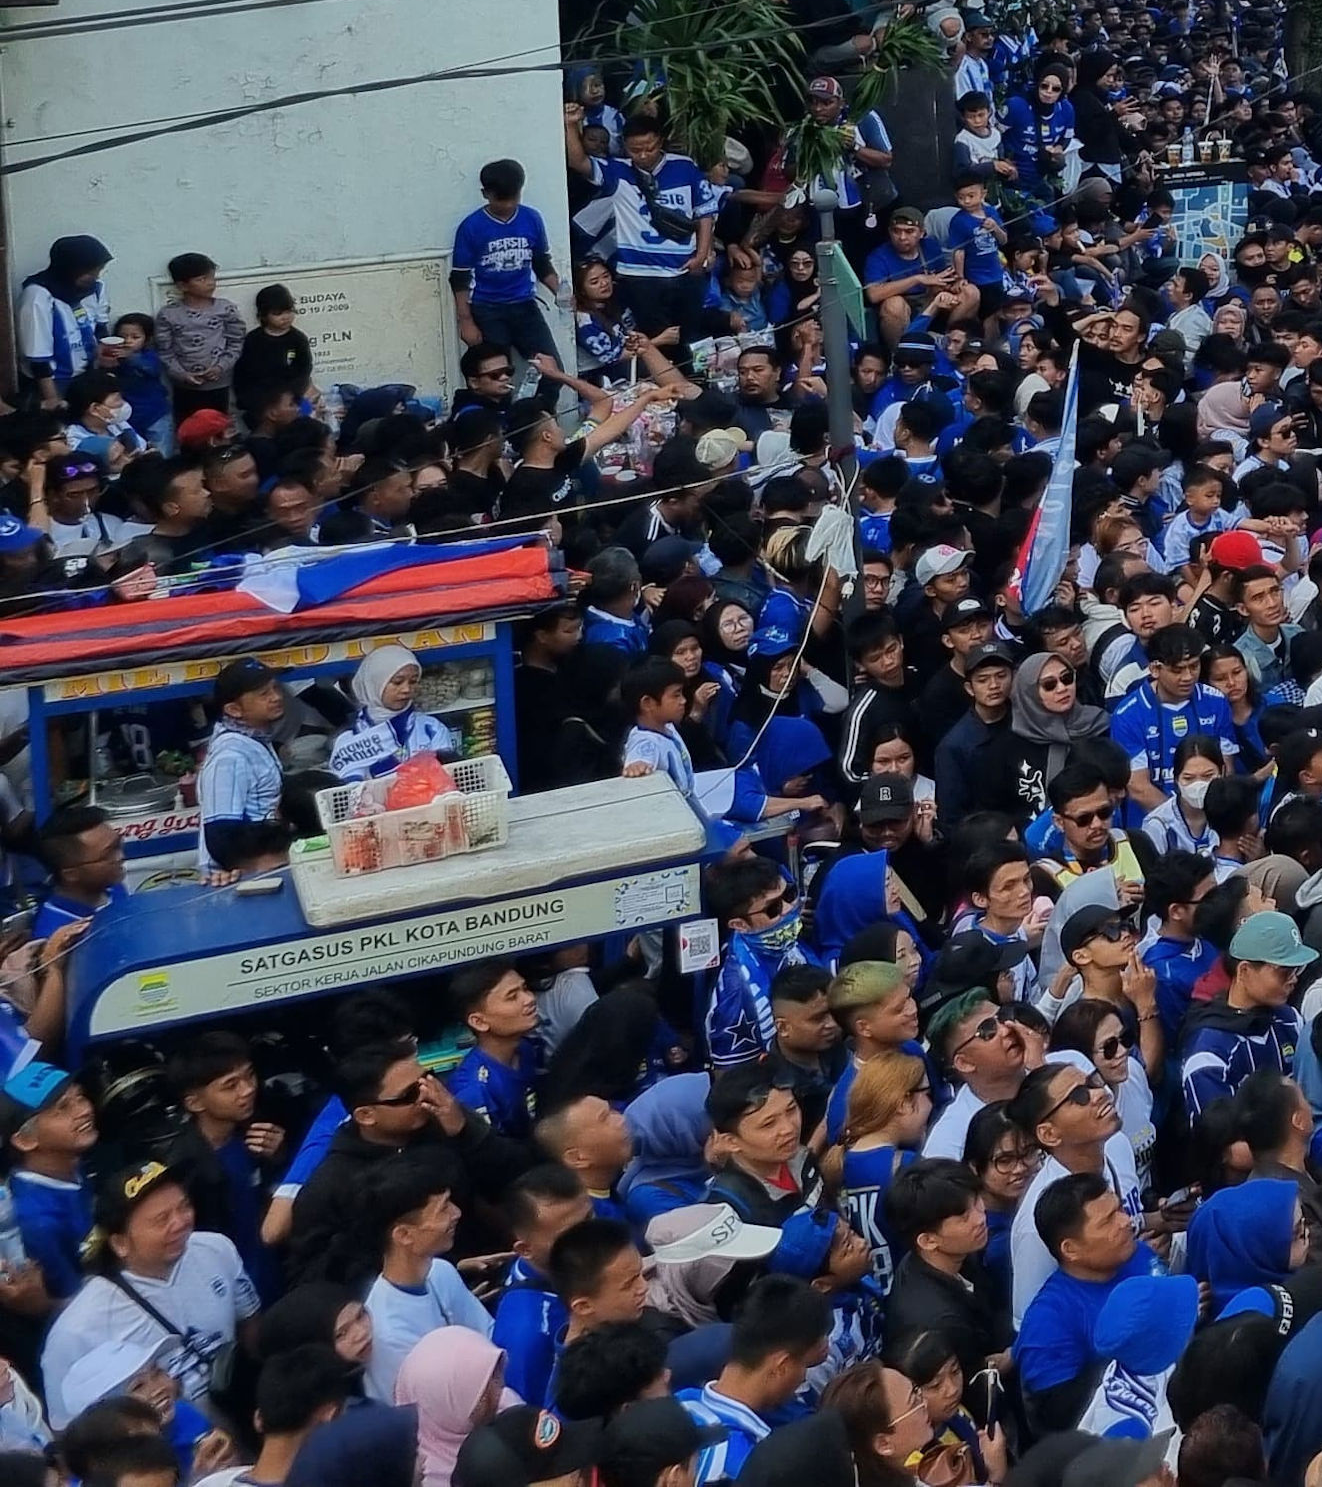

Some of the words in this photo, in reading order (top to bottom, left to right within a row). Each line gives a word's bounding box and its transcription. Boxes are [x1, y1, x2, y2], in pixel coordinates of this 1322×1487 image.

[488, 237, 529, 251] PERSIB
[300, 292, 346, 305] BUDAYA
[322, 330, 352, 343] PLN
[62, 670, 171, 698] MIE
[345, 623, 485, 657] IKAN
[240, 940, 354, 975] SATGASUS
[360, 933, 399, 953] PKL
[405, 919, 459, 943] KOTA
[465, 899, 565, 930] BANDUNG
[254, 976, 312, 1000] SEKTOR
[314, 969, 360, 988] KERJA
[361, 960, 404, 979] JALAN
[407, 942, 506, 969] CIKAPUNDUNG
[508, 930, 552, 950] BARAT
